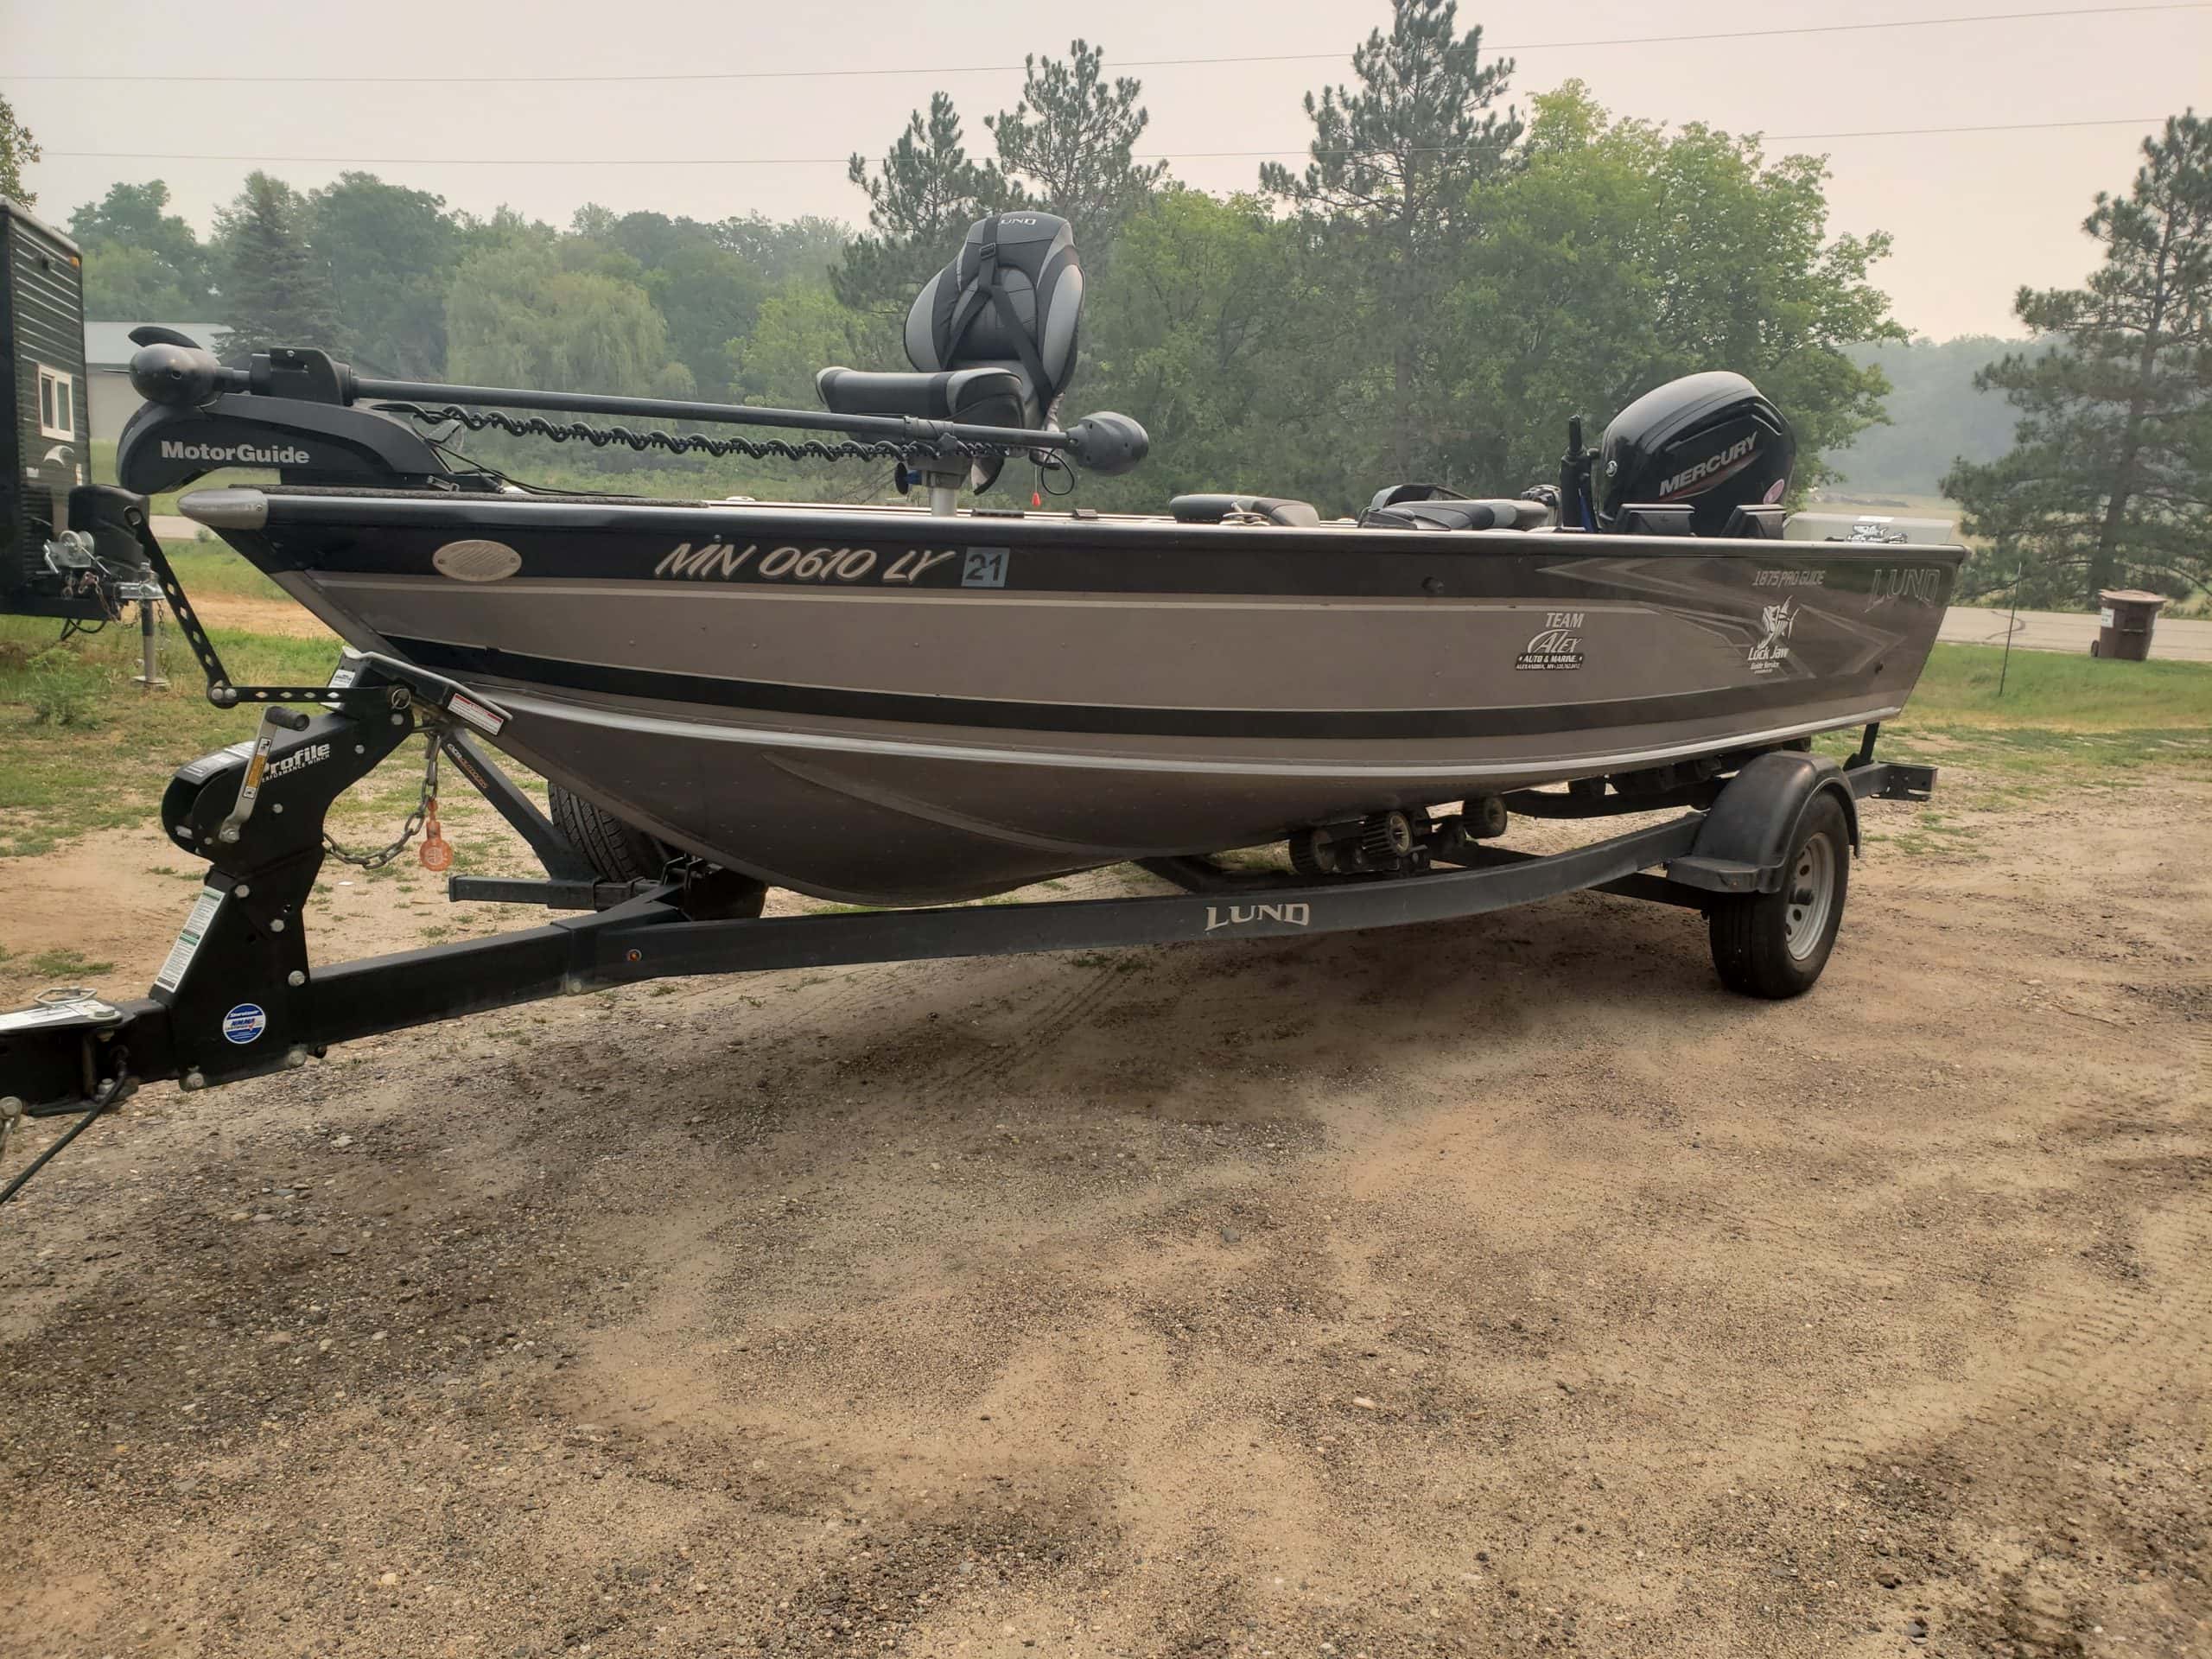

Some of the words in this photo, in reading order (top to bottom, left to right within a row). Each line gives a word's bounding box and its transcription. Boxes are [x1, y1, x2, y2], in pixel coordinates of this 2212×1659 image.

[161, 441, 310, 464] MotorGuide
[1659, 430, 1758, 497] MERCURY
[655, 543, 758, 580] MN
[758, 547, 877, 582] 0610
[882, 550, 957, 584] LY
[965, 553, 1002, 581] 21
[1865, 569, 1941, 613] LUND
[1546, 612, 1585, 628] TEAM
[1747, 646, 1770, 660] Lock
[262, 761, 306, 783] ERFORMANCE
[1205, 903, 1310, 931] LUND
